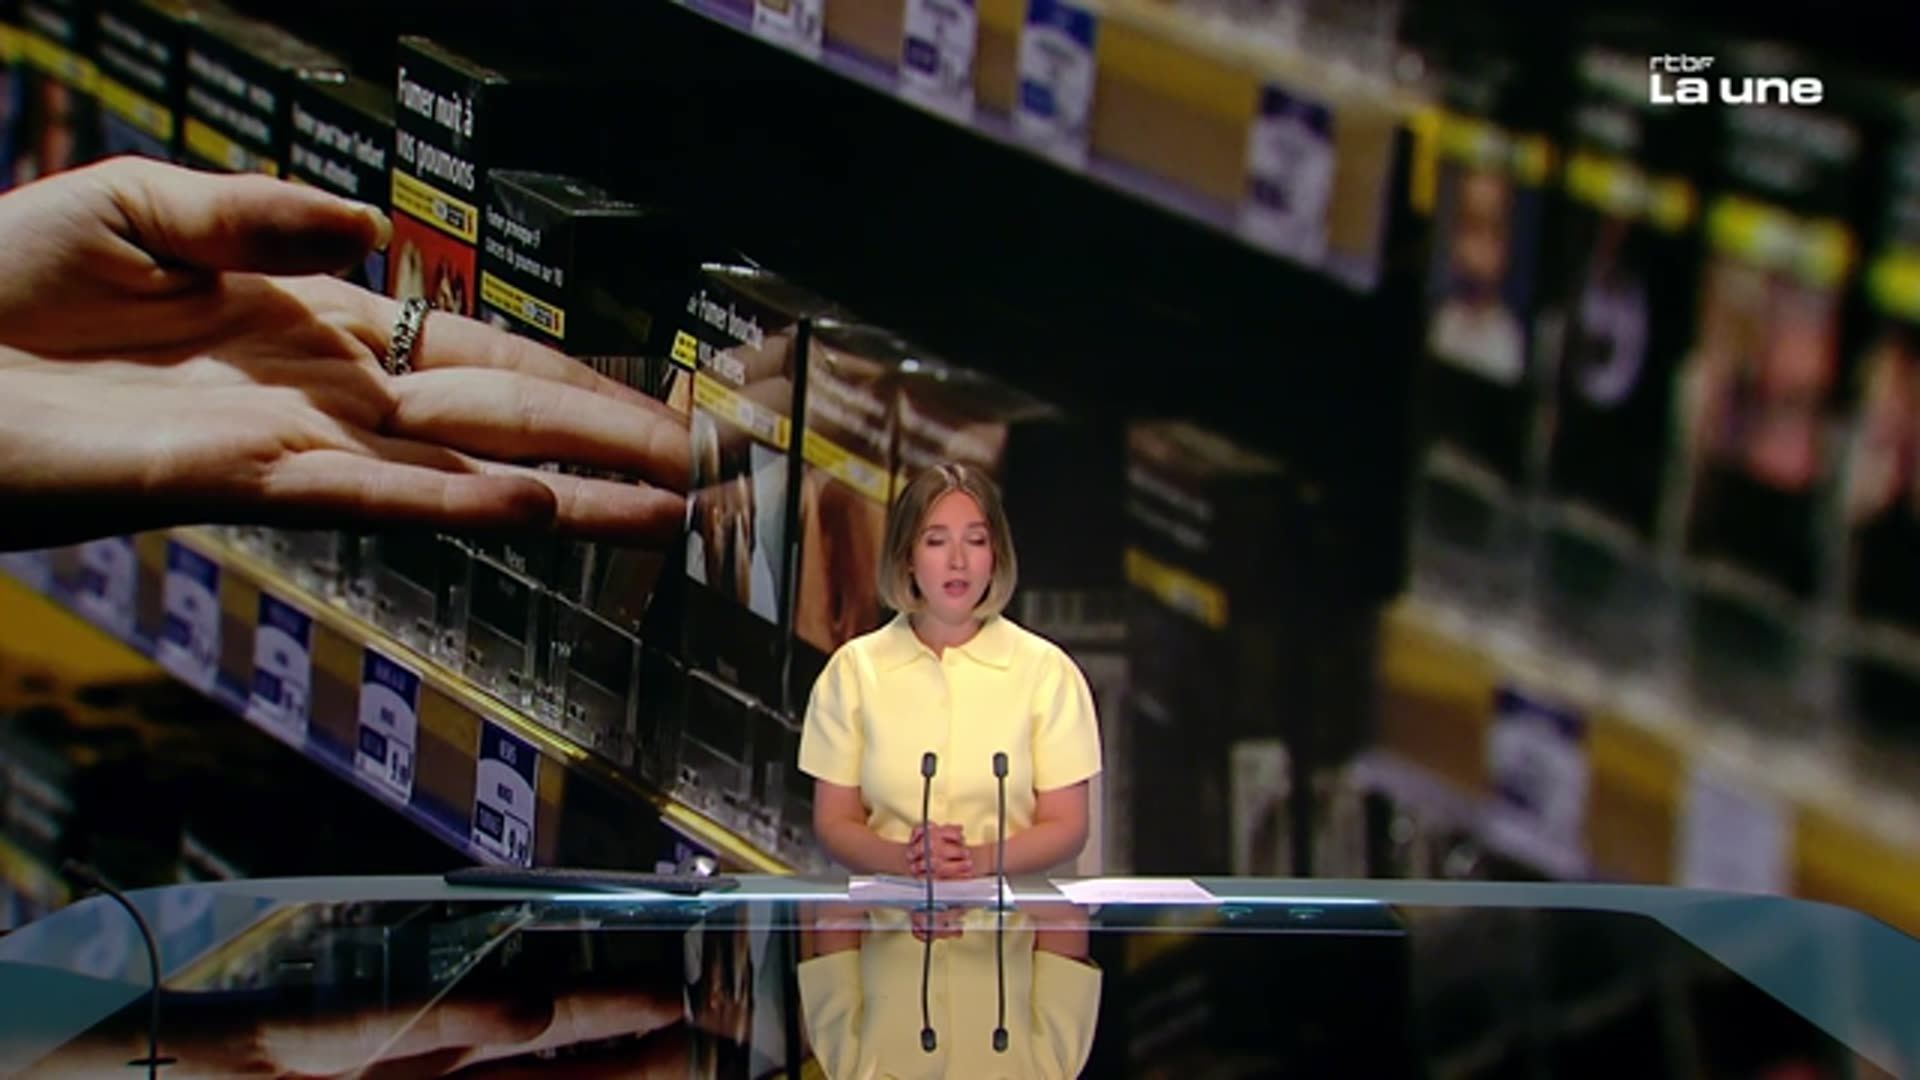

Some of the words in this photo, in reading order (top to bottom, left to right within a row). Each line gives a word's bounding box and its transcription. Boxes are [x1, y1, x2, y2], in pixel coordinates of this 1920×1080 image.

[398, 66, 435, 120] Fumer
[434, 91, 463, 133] nuit
[463, 97, 473, 138] à
[396, 128, 415, 163] vos
[416, 140, 475, 191] poumons
